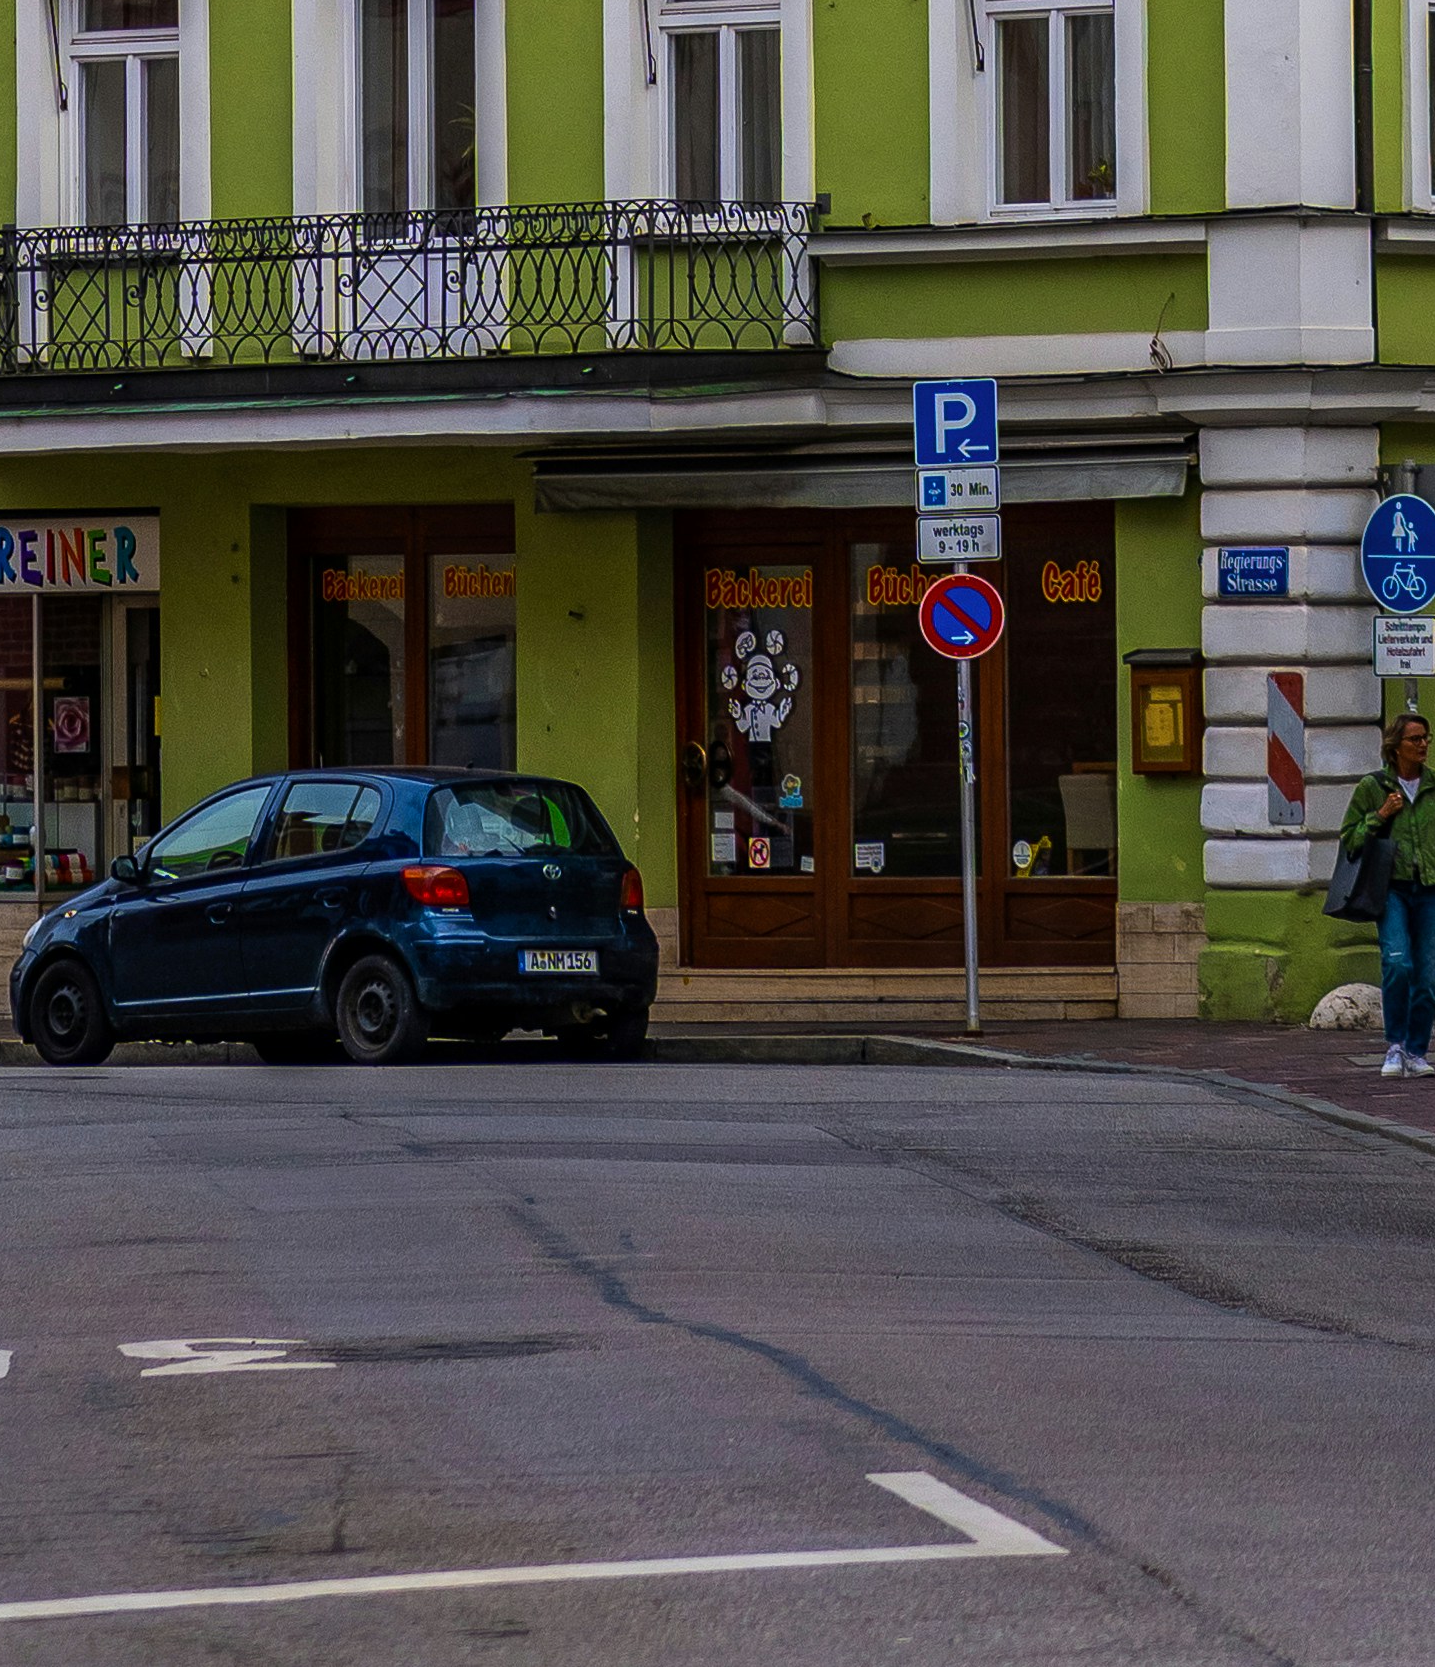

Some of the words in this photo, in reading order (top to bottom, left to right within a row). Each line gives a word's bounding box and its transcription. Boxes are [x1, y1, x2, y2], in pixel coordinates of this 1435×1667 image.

[934, 392, 977, 454] P
[950, 483, 963, 496] 30
[968, 482, 992, 496] Min.
[933, 523, 984, 539] werktags
[938, 540, 946, 553] 9
[956, 539, 969, 553] 19
[1220, 550, 1286, 575] Regierungs-
[705, 566, 814, 609] Bäckerei
[867, 564, 944, 605] Büch
[1042, 559, 1103, 603] Café
[1226, 573, 1278, 592] Strasse
[1421, 634, 1433, 644] und
[1400, 659, 1411, 669] frei
